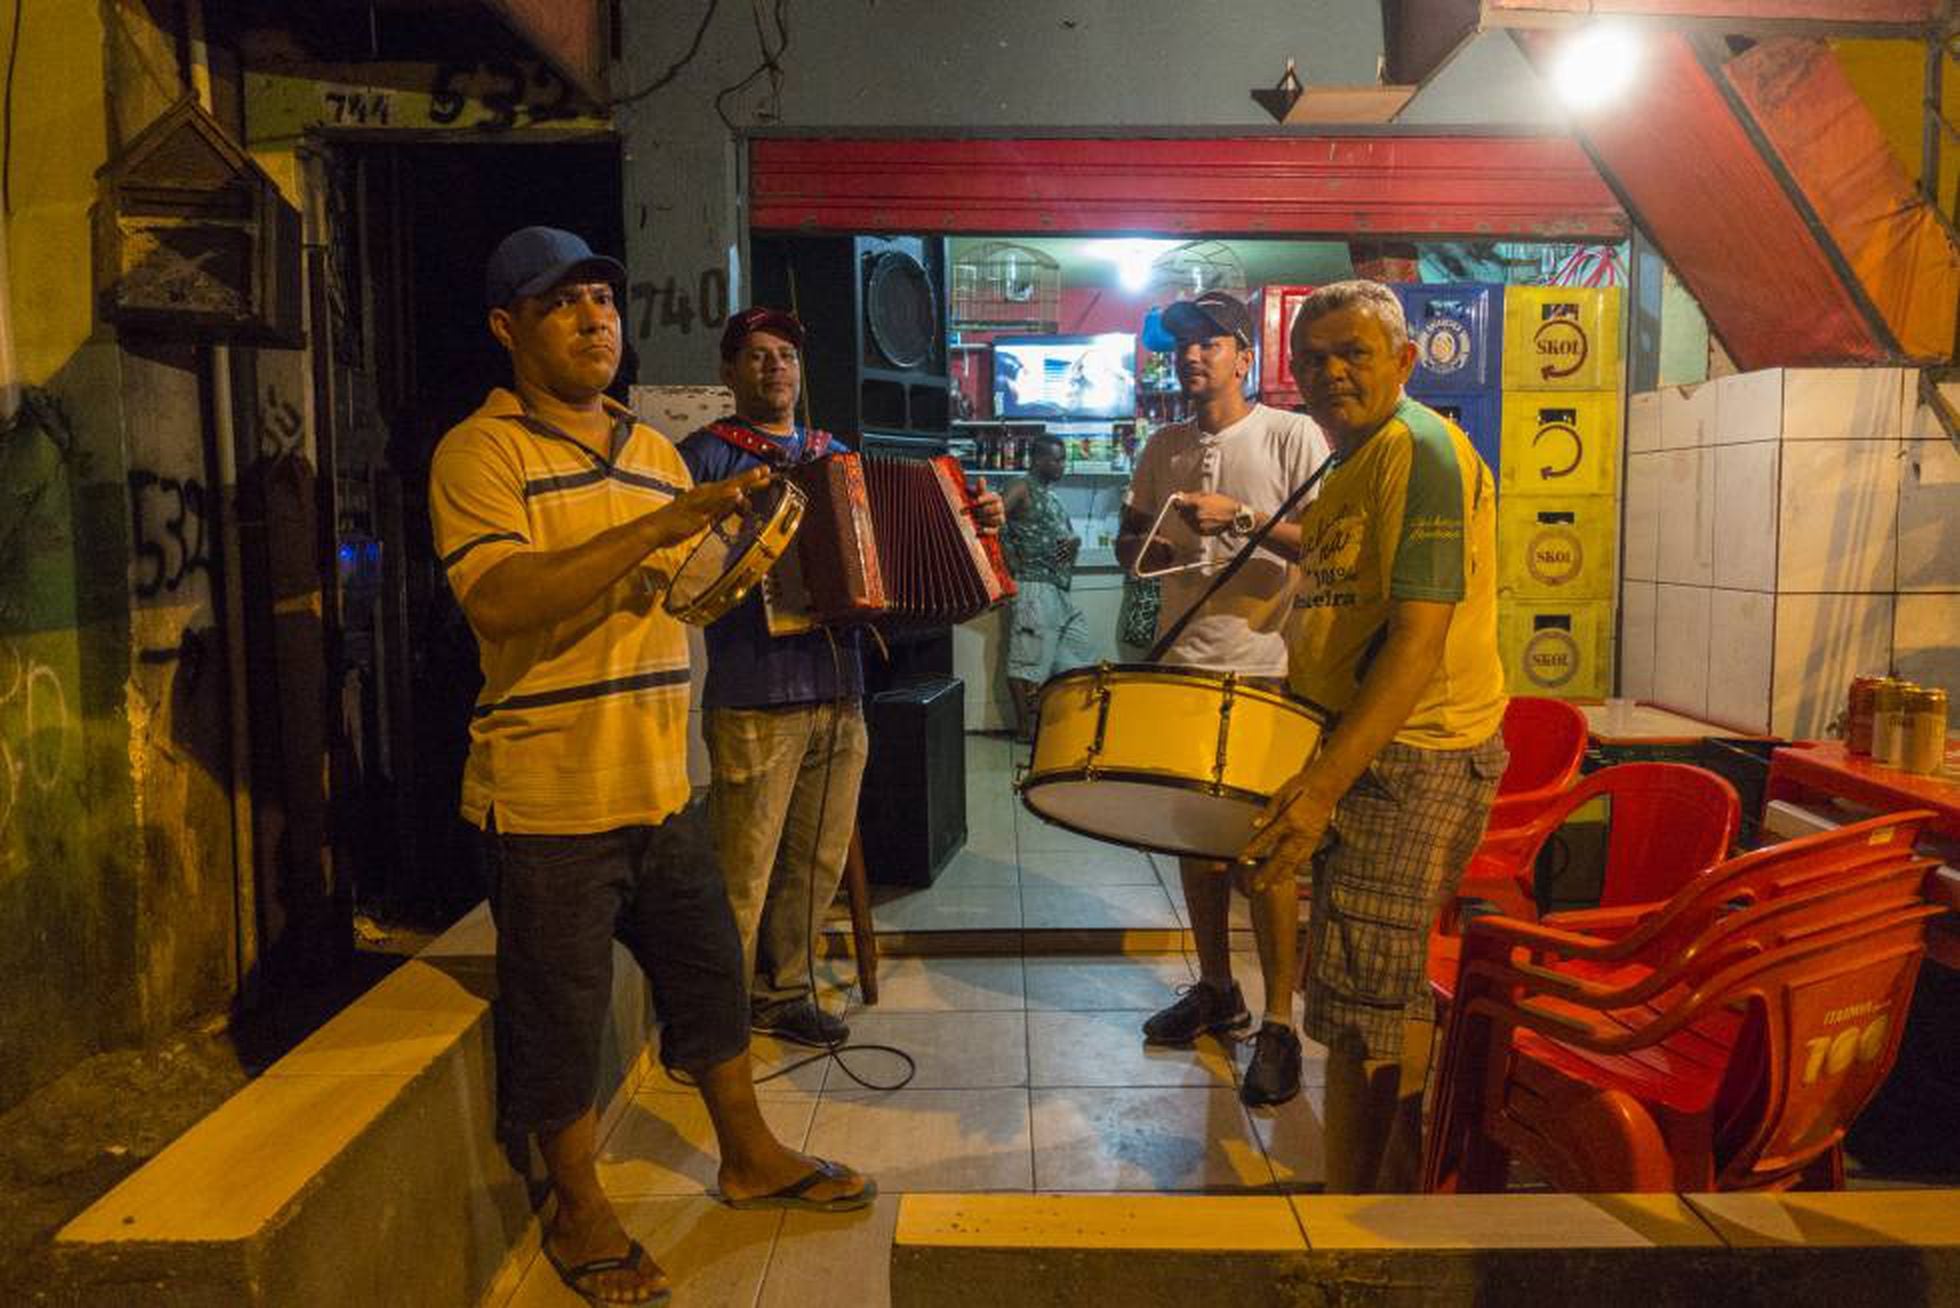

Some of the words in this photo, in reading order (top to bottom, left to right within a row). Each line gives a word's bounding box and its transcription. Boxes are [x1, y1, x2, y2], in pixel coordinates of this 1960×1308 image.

[324, 92, 389, 125] 744
[631, 268, 727, 339] 740
[1535, 339, 1580, 356] SKOL
[1536, 549, 1571, 564] SKOL
[1532, 653, 1569, 667] SKOL
